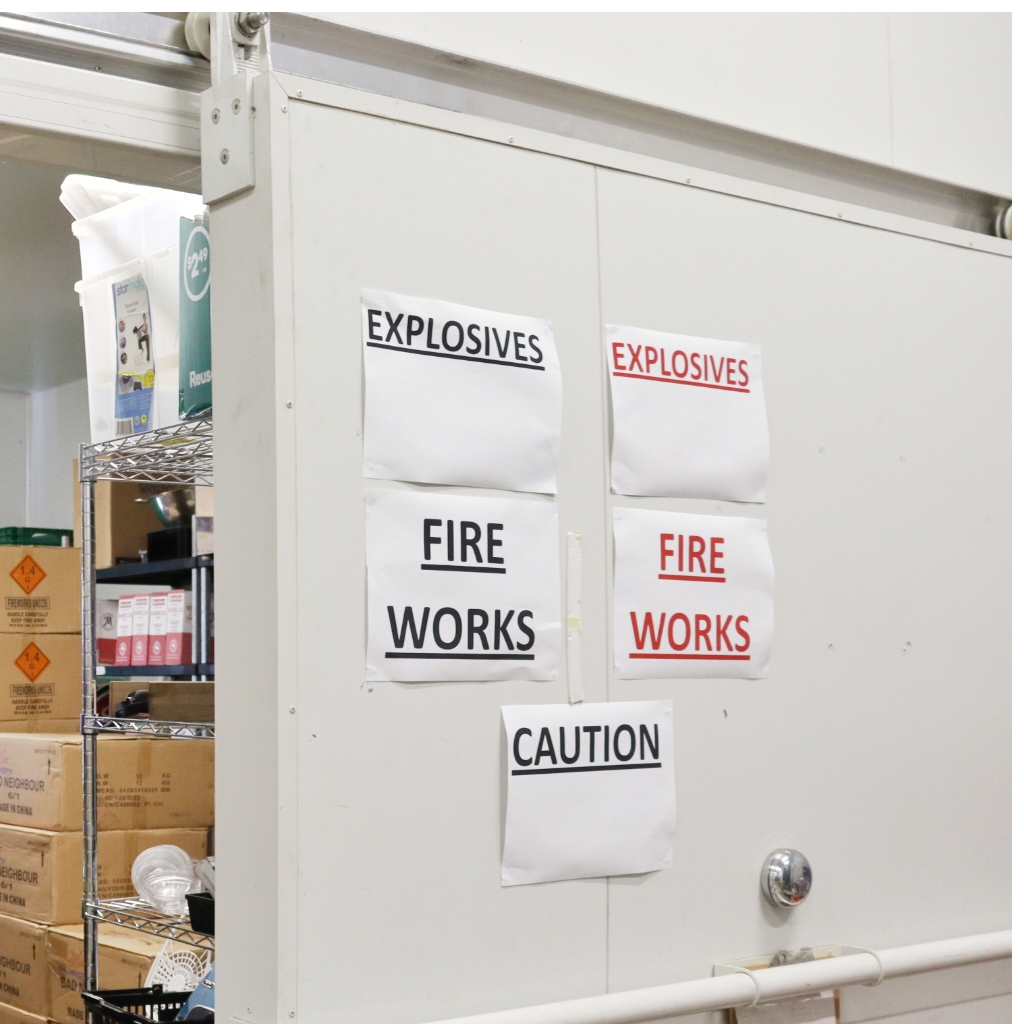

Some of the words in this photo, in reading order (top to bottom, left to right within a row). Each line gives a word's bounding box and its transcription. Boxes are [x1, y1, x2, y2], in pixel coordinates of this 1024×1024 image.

[366, 308, 544, 365] EXPLOSIVES
[612, 342, 750, 388] EXPLOSIVES
[422, 518, 505, 567] FIRE
[659, 532, 725, 575] FIRE
[20, 565, 36, 576] 1.4
[387, 605, 536, 653] WORKS
[629, 611, 751, 653] WORKS
[25, 652, 40, 662] 1.4
[512, 722, 661, 767] CAUTION
[4, 777, 45, 792] NEIGHBOUR
[8, 792, 20, 800] 6/1
[10, 804, 16, 813] IN
[17, 805, 33, 816] CHINA
[0, 881, 13, 890] 6/1
[3, 893, 8, 902] IN
[9, 895, 26, 907] CHINA
[3, 981, 20, 996] CHINA
[67, 1007, 84, 1021] MADE
